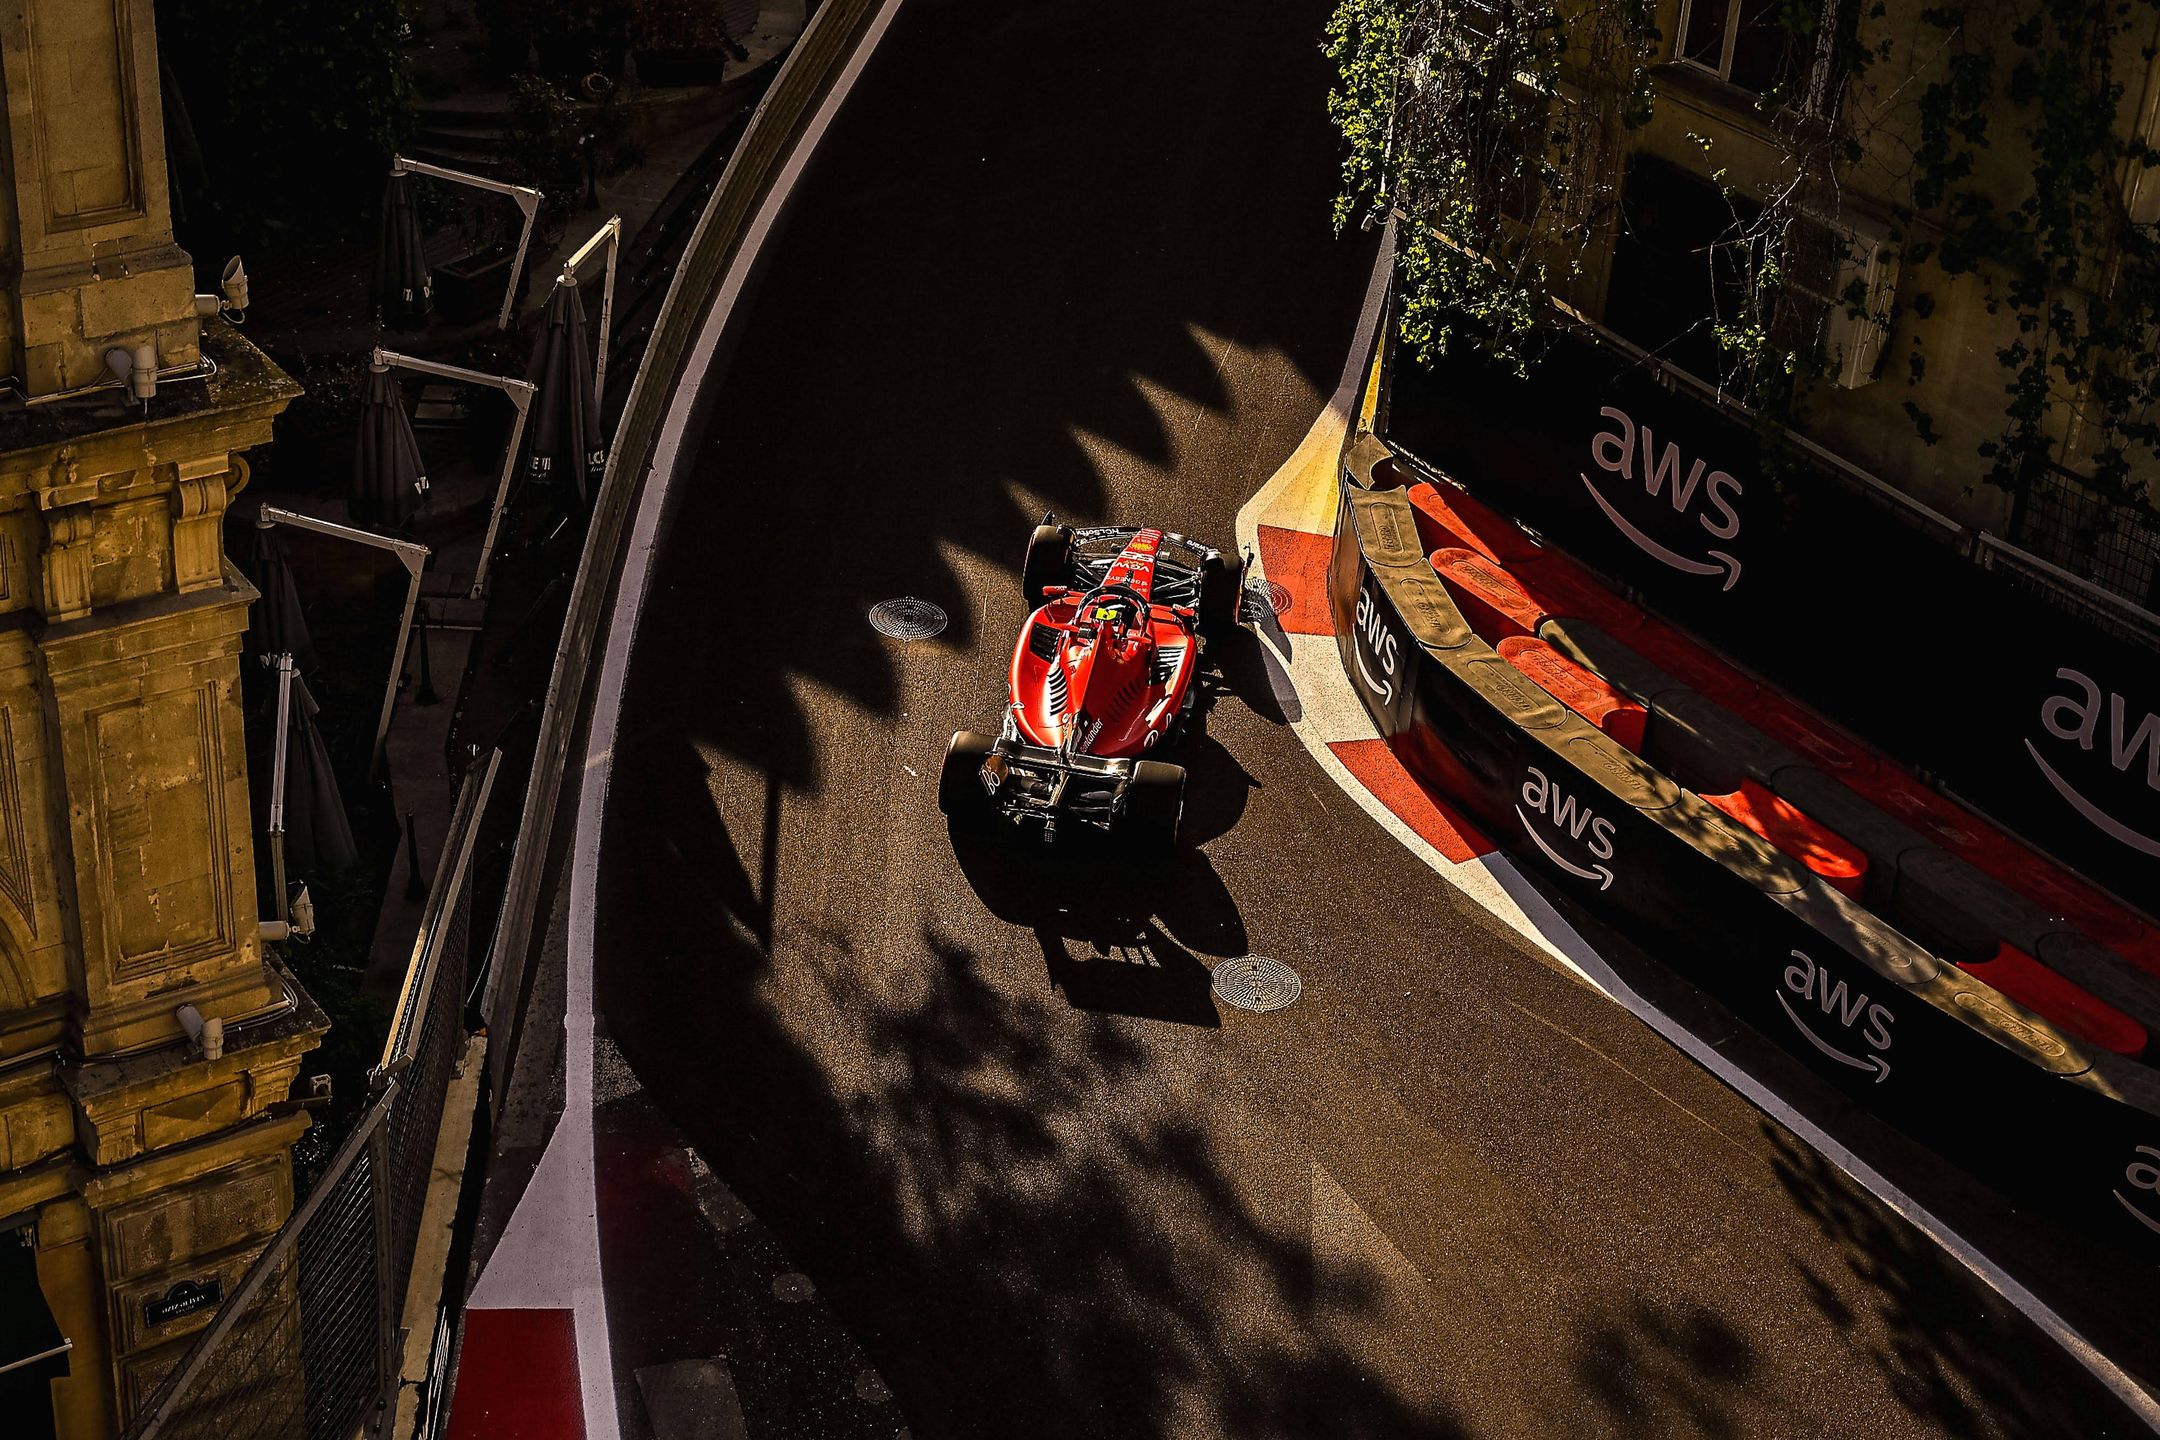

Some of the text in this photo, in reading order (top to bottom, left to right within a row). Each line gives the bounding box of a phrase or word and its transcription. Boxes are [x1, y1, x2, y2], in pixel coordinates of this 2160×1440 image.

[1591, 406, 1744, 541] aws
[1355, 586, 1398, 677] aws
[1078, 717, 1104, 754] antander
[2040, 667, 2160, 793] aw
[1522, 765, 1616, 861] aws
[1784, 948, 1896, 1051] aws
